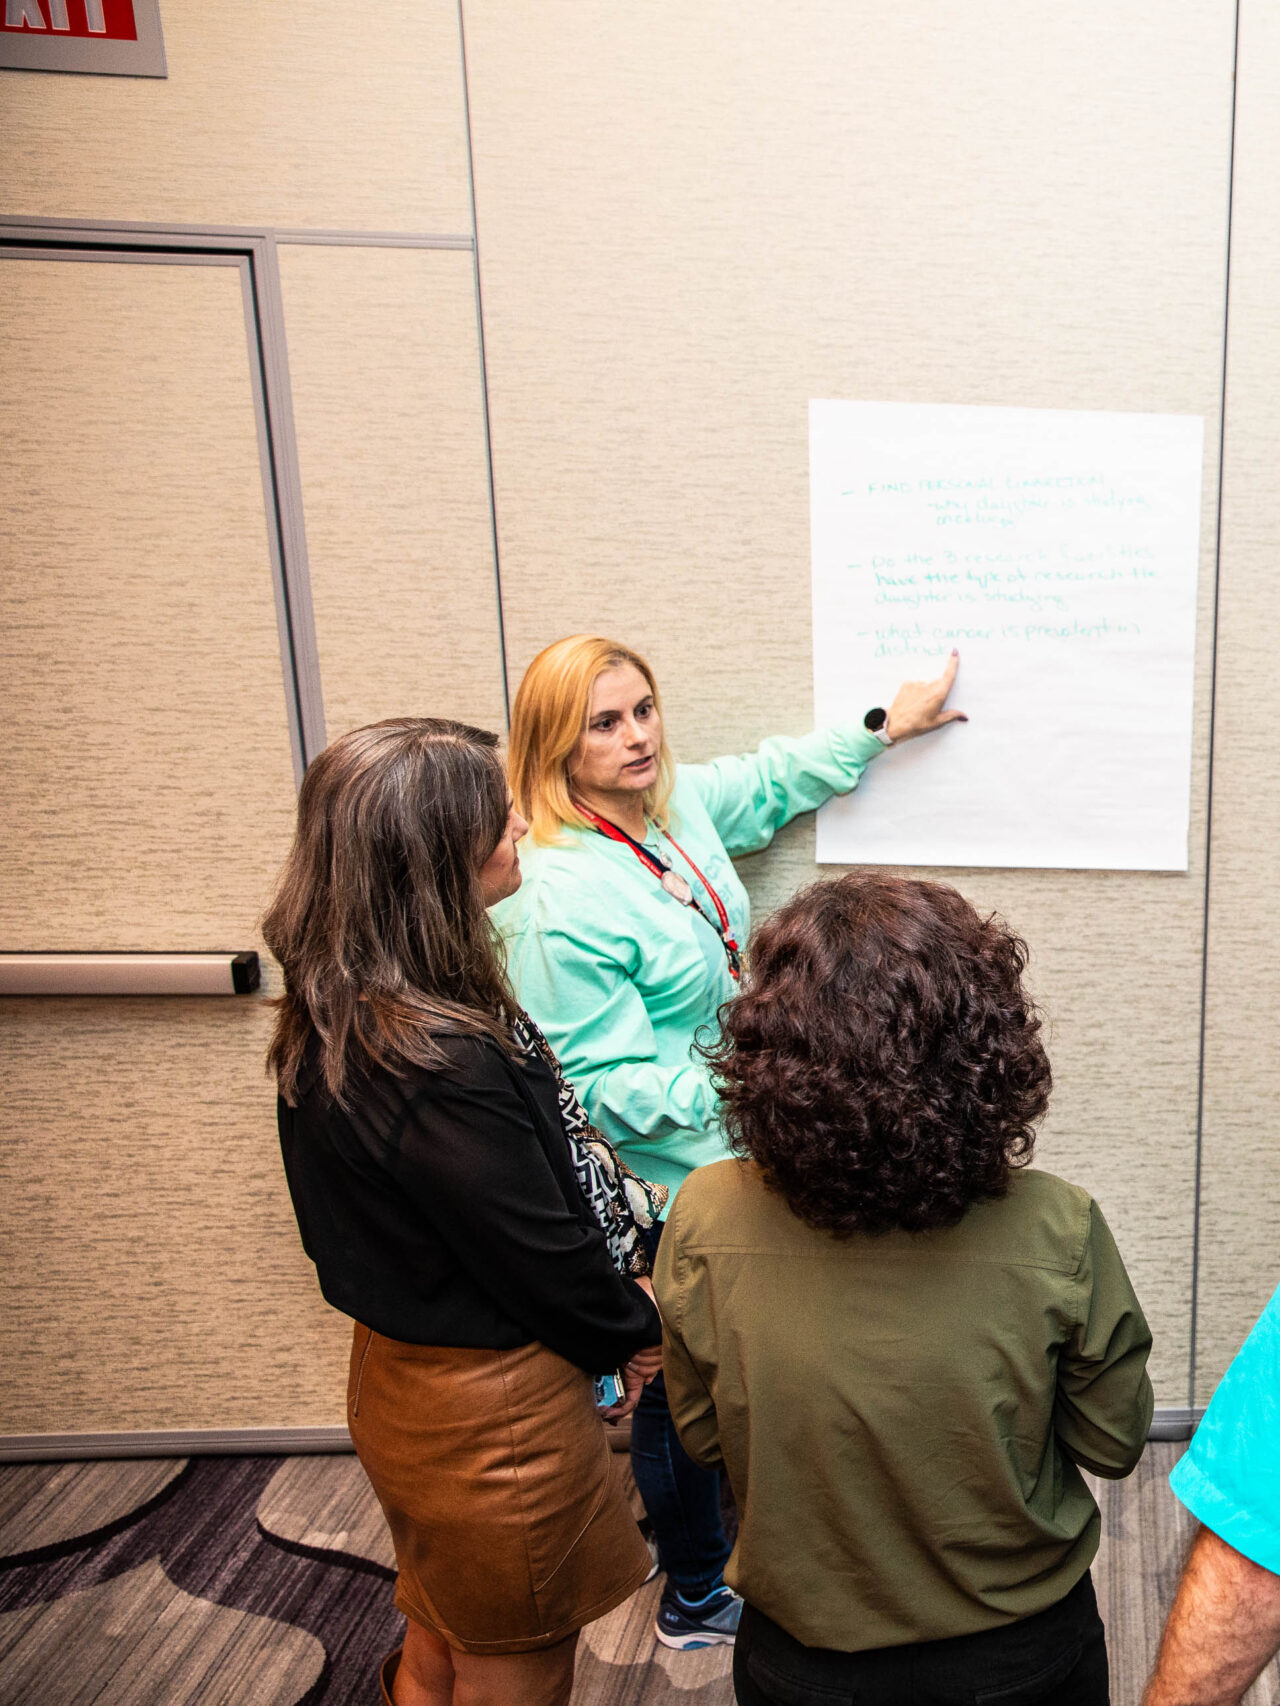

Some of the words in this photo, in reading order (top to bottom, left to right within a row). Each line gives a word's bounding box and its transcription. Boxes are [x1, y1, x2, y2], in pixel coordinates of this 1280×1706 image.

[875, 573, 917, 587] have
[924, 572, 959, 584] the
[933, 624, 992, 640] cancer
[1002, 626, 1019, 637] is
